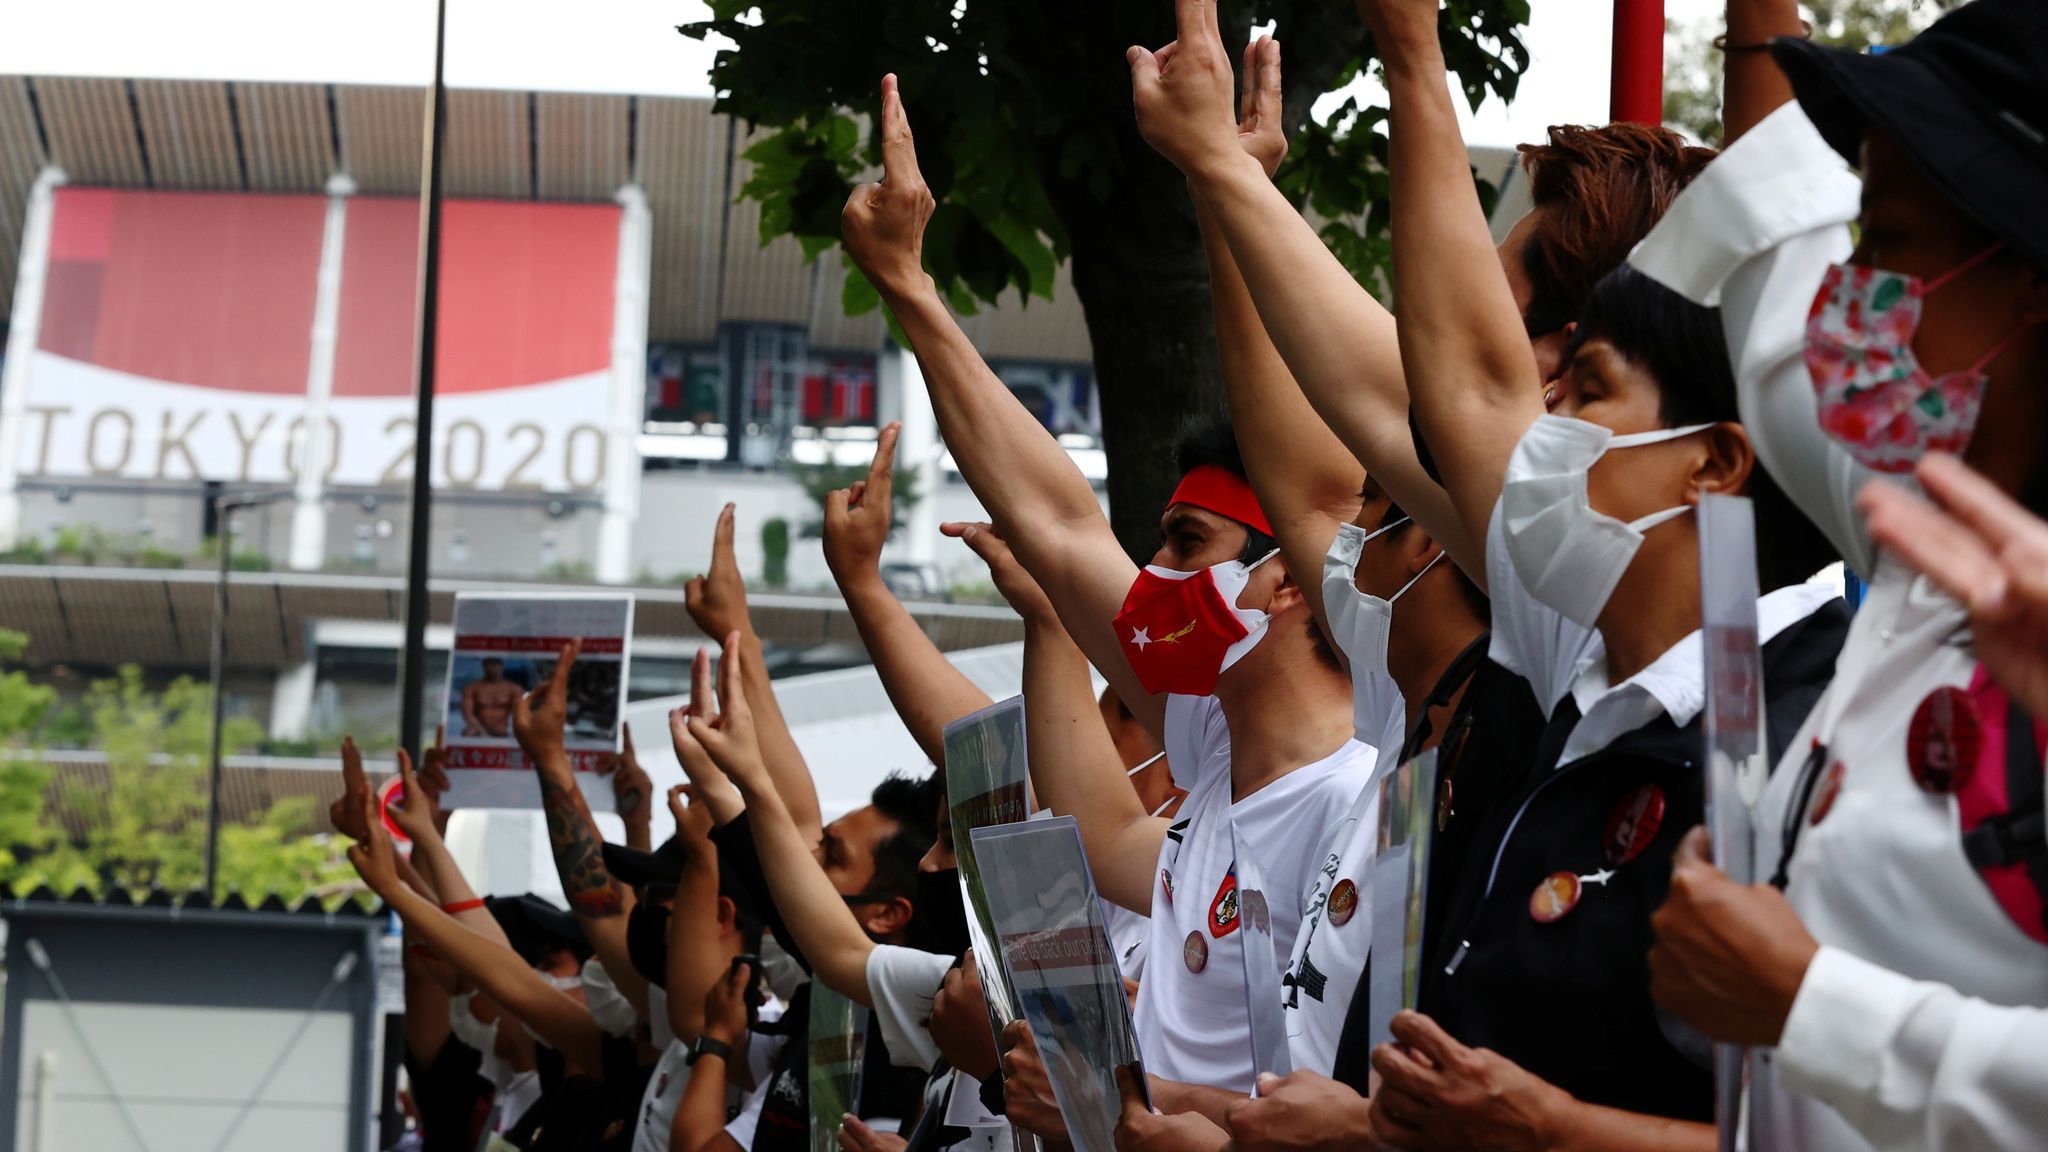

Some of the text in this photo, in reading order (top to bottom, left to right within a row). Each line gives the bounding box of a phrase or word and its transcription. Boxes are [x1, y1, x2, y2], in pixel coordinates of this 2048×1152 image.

[25, 405, 607, 489] TOKYO 2020
[1063, 938, 1082, 958] our
